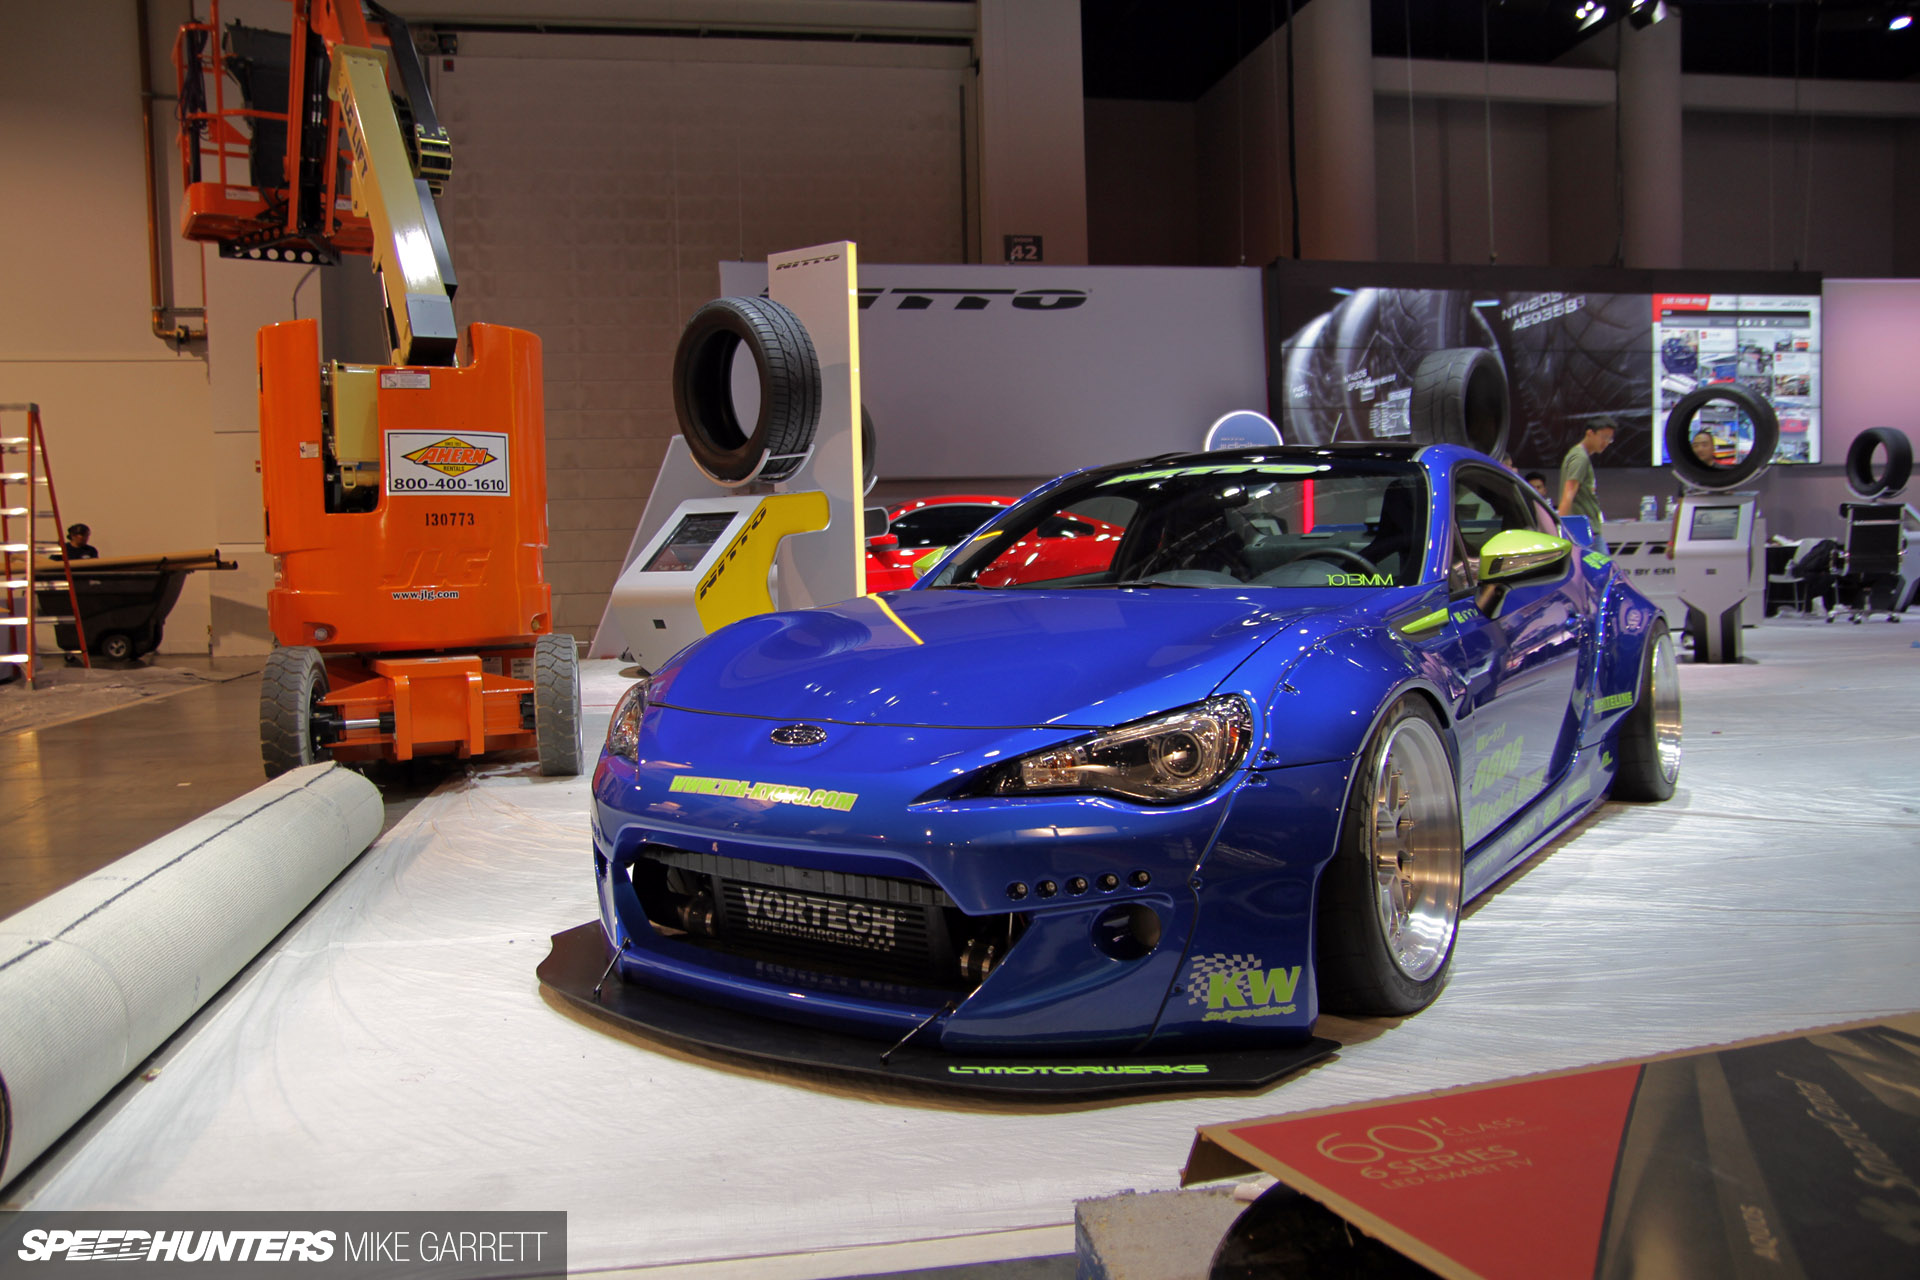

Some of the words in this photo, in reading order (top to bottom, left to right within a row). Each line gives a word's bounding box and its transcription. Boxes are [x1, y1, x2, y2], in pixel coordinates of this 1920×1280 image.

[352, 126, 369, 179] LIFT
[776, 254, 840, 271] NITTO
[1011, 245, 1038, 260] 42
[414, 447, 489, 465] AHERN
[394, 477, 505, 491] 800-400-1610
[425, 512, 475, 527] 130773
[700, 507, 767, 600] NITTO
[391, 590, 460, 601] www.jlg.com
[668, 775, 859, 812] WWW.TRA-KYOTO.COM
[741, 887, 896, 938] VORTECH
[747, 917, 863, 948] SUPERCHARGERS
[1206, 965, 1302, 1010] KW
[1442, 1117, 1526, 1137] CLASS
[1361, 1166, 1389, 1180] 6
[1387, 1144, 1519, 1176] SERIES
[1380, 1175, 1426, 1190] LED
[1425, 1163, 1501, 1183] SMART
[1501, 1156, 1534, 1170] TV
